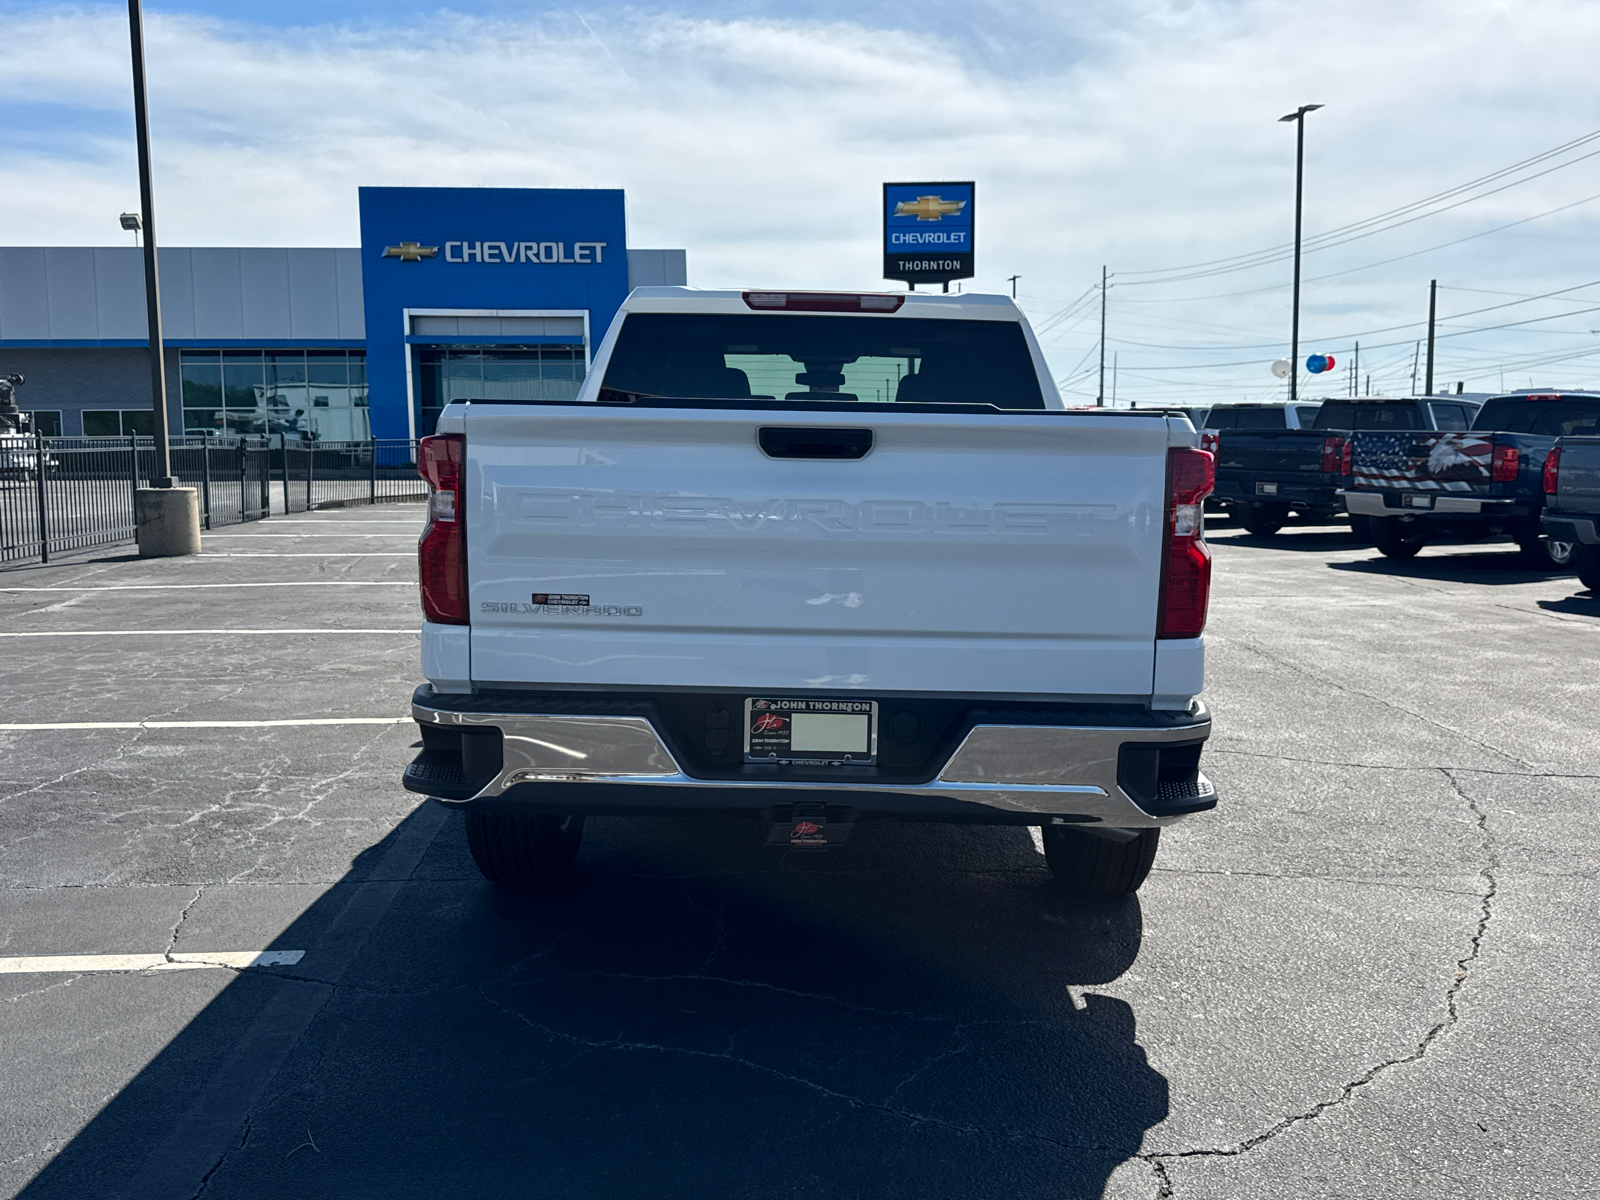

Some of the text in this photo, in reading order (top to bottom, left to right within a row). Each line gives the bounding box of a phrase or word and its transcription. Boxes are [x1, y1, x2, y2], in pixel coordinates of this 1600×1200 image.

[891, 232, 967, 244] CHEVROLET
[444, 241, 607, 264] CHEVROLET
[898, 260, 961, 271] THORNTON
[481, 602, 643, 617] SILVERADO
[775, 700, 806, 710] JOHN
[808, 701, 870, 712] THORNTON
